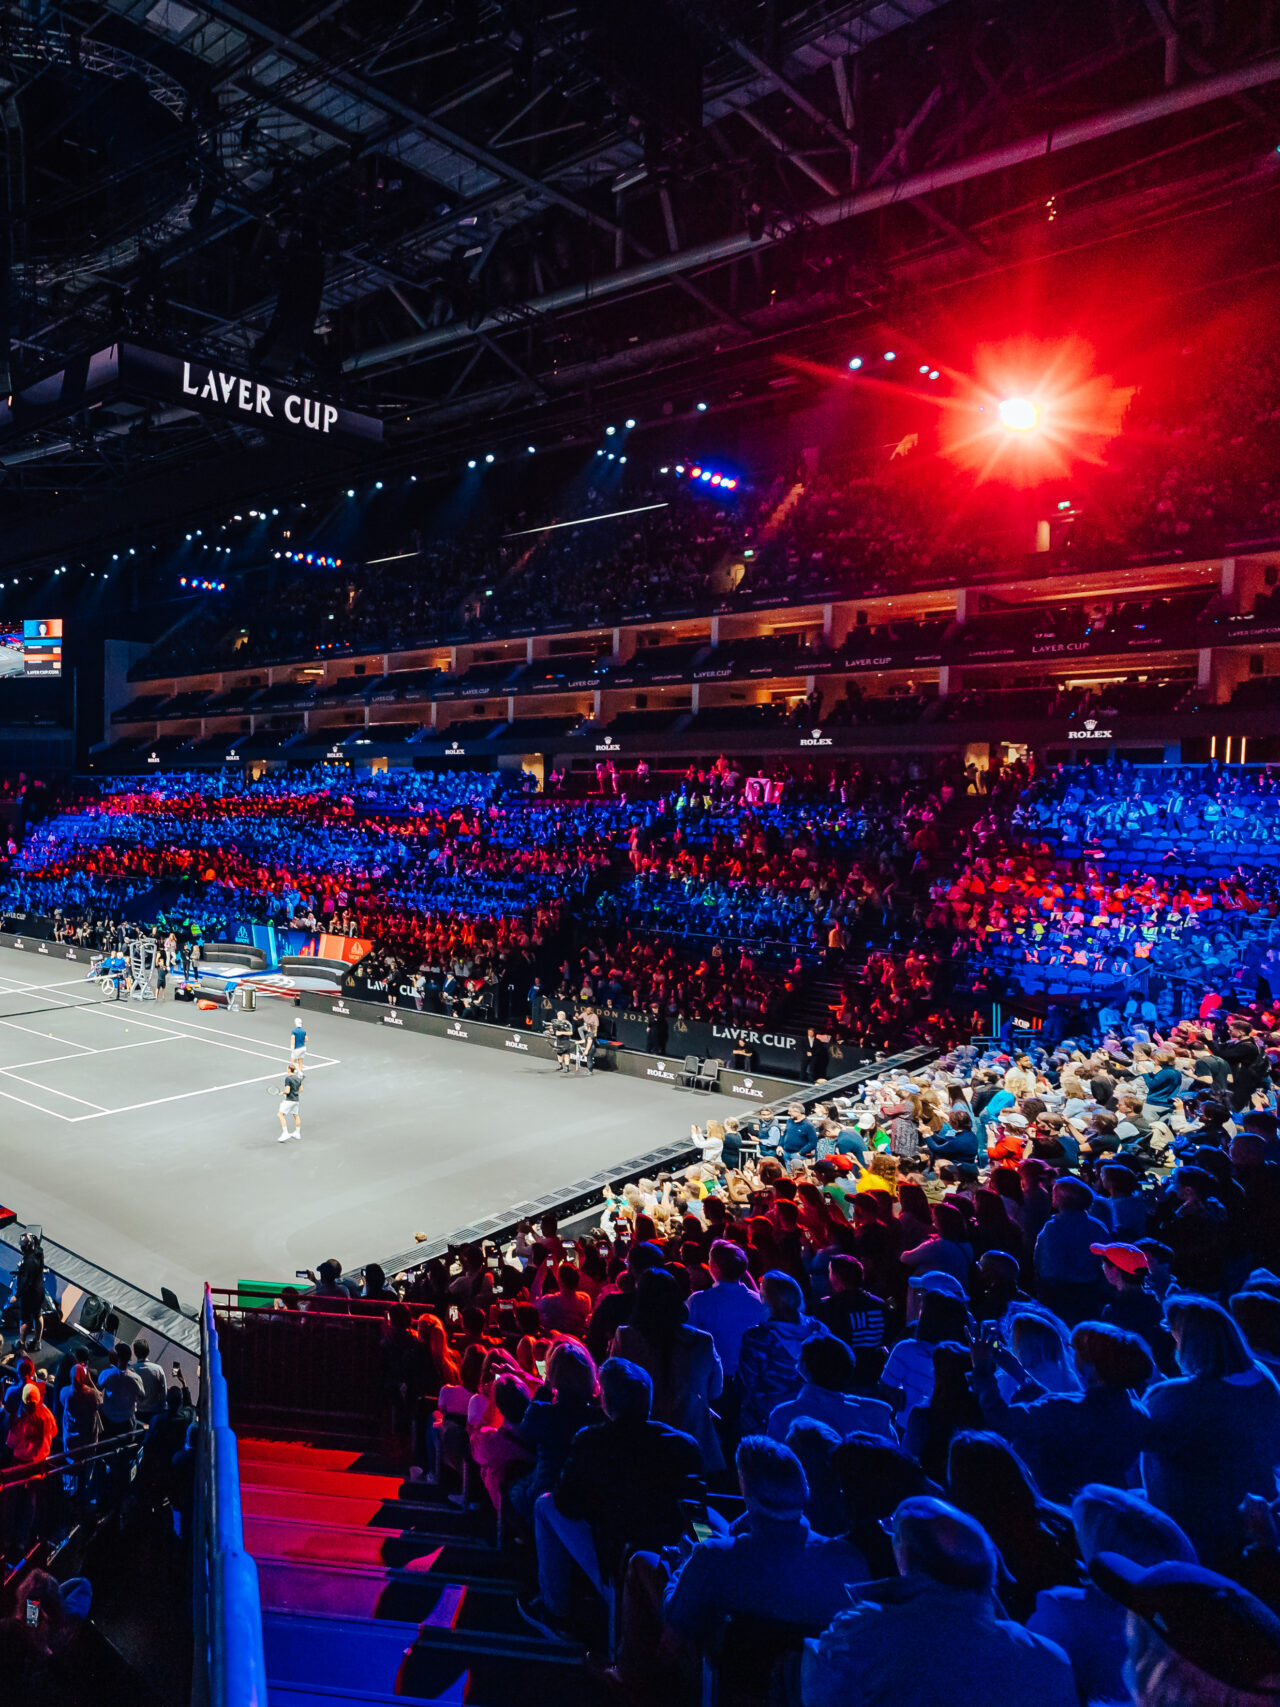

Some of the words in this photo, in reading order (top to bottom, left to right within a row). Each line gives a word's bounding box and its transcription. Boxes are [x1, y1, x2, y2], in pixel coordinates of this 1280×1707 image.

[183, 361, 274, 418] LAVER
[284, 394, 338, 433] CUP
[1032, 643, 1064, 653] LAVER
[1066, 641, 1091, 650] CUP
[845, 657, 871, 668] LAVER
[872, 656, 893, 665] CUP
[693, 671, 715, 679] LAVER
[1068, 730, 1113, 739] ROLEX
[800, 738, 832, 746] ROLEX
[332, 1006, 350, 1015] ROLEX
[574, 1005, 618, 1018] LODON
[623, 1012, 649, 1023] 2022
[384, 1016, 404, 1025] ROLEX
[447, 1028, 468, 1038] ROLEX
[712, 1025, 761, 1044] LAVER
[505, 1040, 529, 1050] ROLEX
[647, 1068, 675, 1080] ROLEX
[732, 1085, 764, 1098] ROLEX
